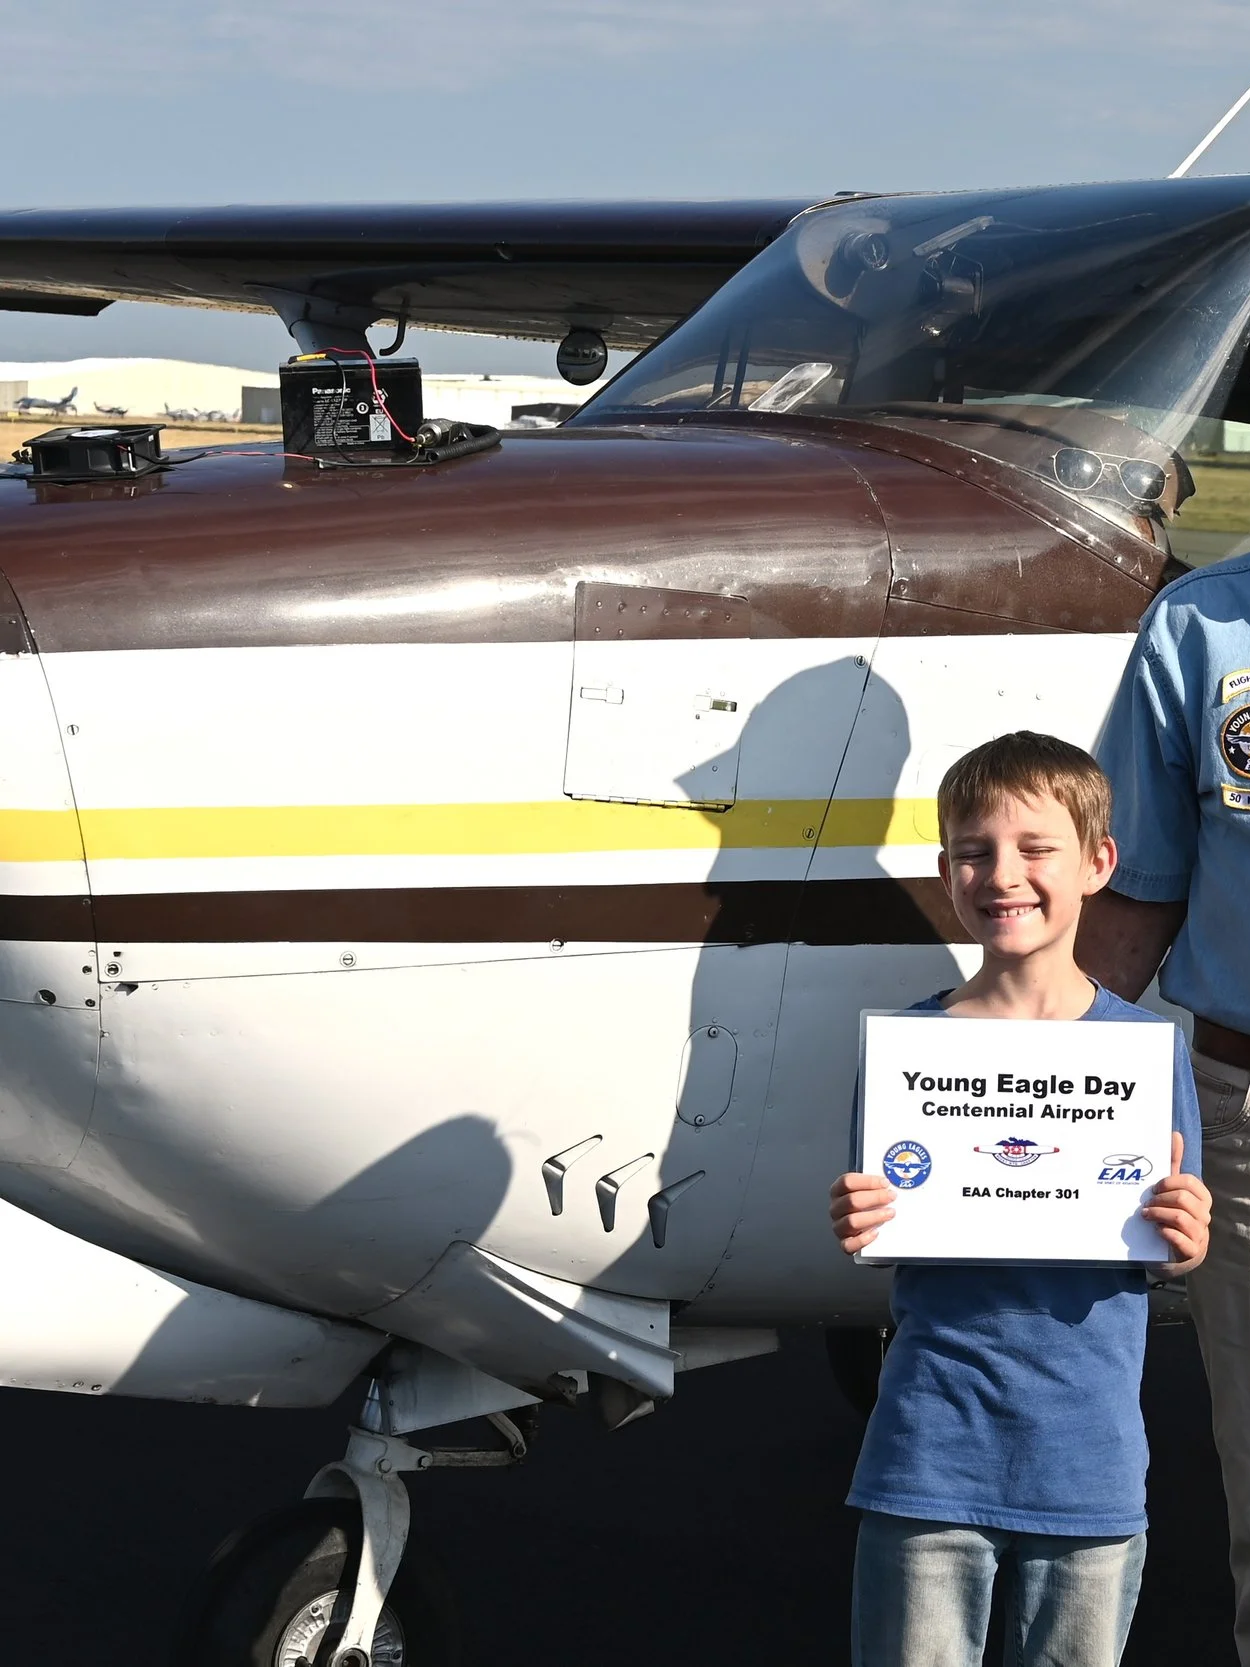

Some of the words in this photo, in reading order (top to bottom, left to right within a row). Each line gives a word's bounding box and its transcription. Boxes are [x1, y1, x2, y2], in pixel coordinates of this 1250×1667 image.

[1229, 793, 1242, 803] 50
[903, 1072, 987, 1098] Young
[997, 1074, 1075, 1100] Eagle
[1084, 1076, 1137, 1101] Day
[921, 1102, 1034, 1119] Centennial
[1041, 1105, 1115, 1123] Airport
[887, 1143, 906, 1159] YOUNG
[909, 1143, 928, 1160] EAGLES
[1098, 1168, 1142, 1181] EAA
[962, 1187, 992, 1198] EAA
[996, 1188, 1052, 1201] Chapter
[1055, 1189, 1080, 1200] 301
